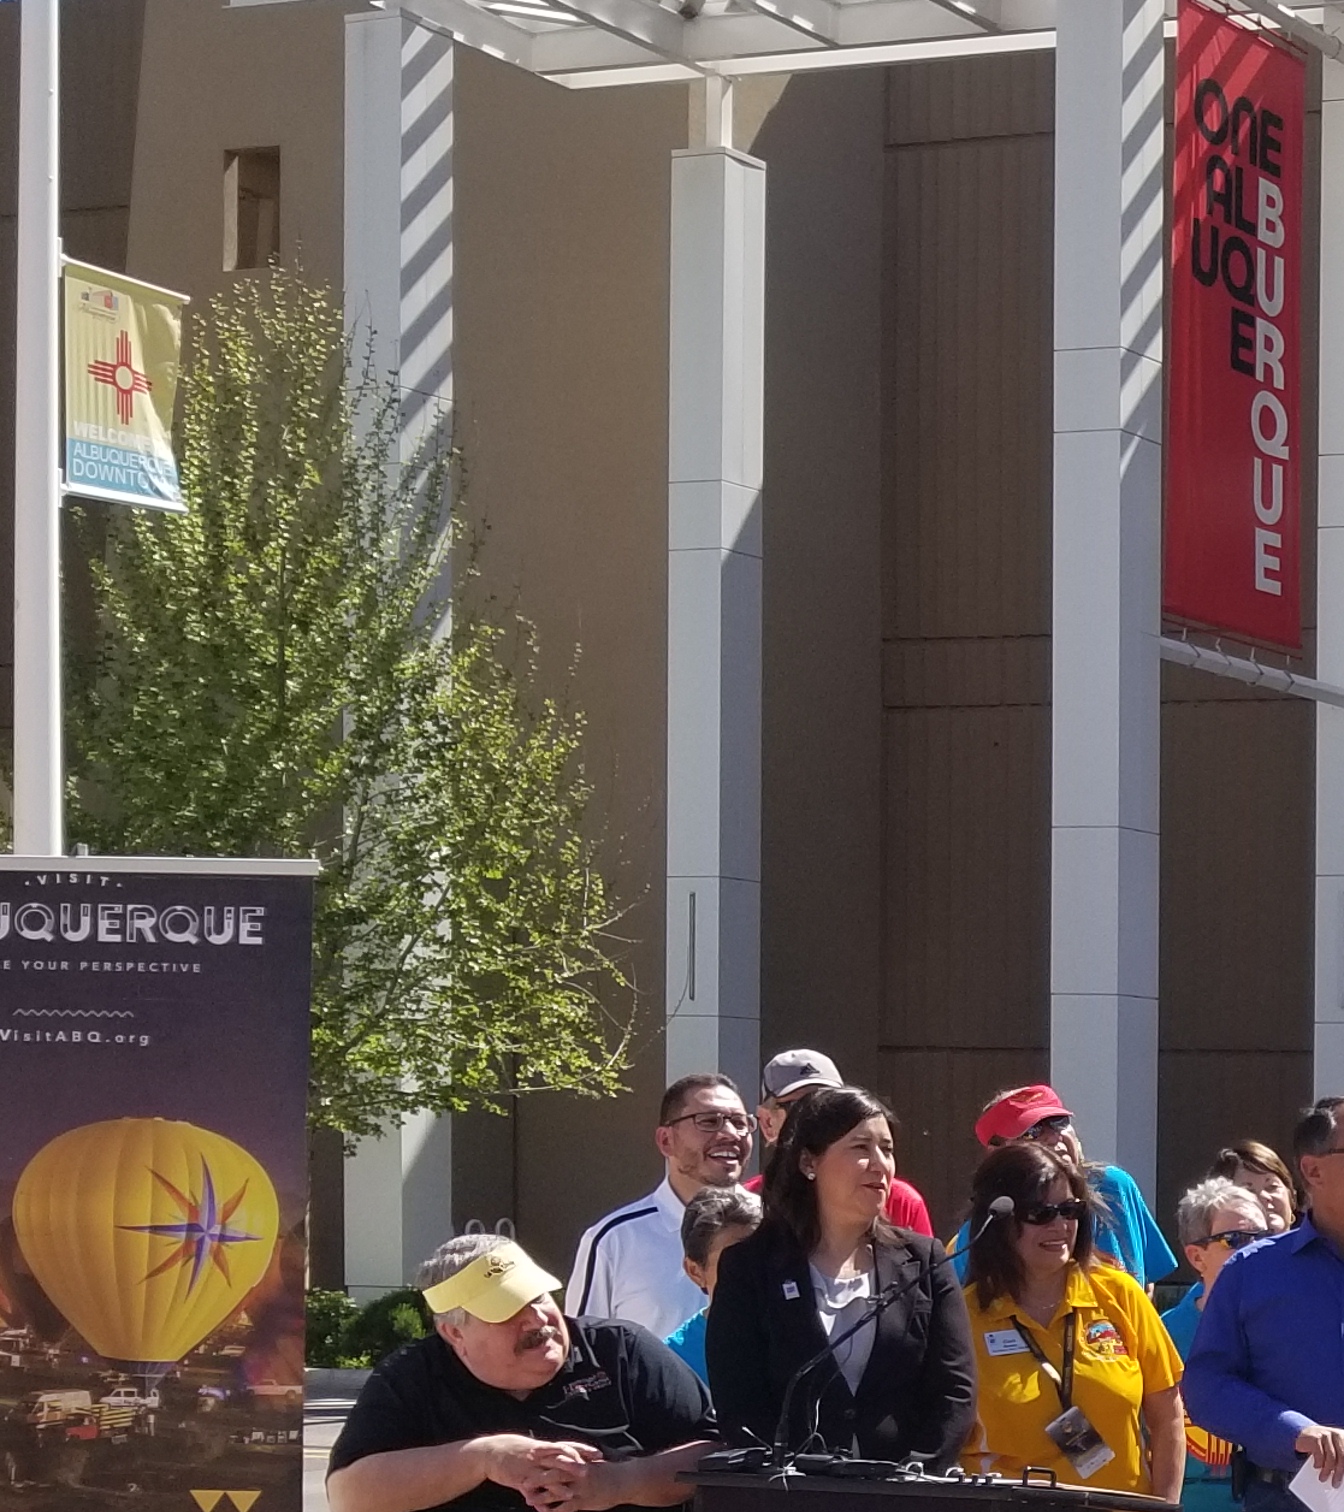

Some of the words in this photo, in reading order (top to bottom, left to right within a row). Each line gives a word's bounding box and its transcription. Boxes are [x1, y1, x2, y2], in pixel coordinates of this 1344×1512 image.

[1194, 78, 1283, 178] ONE
[21, 960, 69, 972] YOUR
[80, 962, 202, 974] PERSPECTIVE
[0, 1029, 150, 1047] VisitABQ.org
